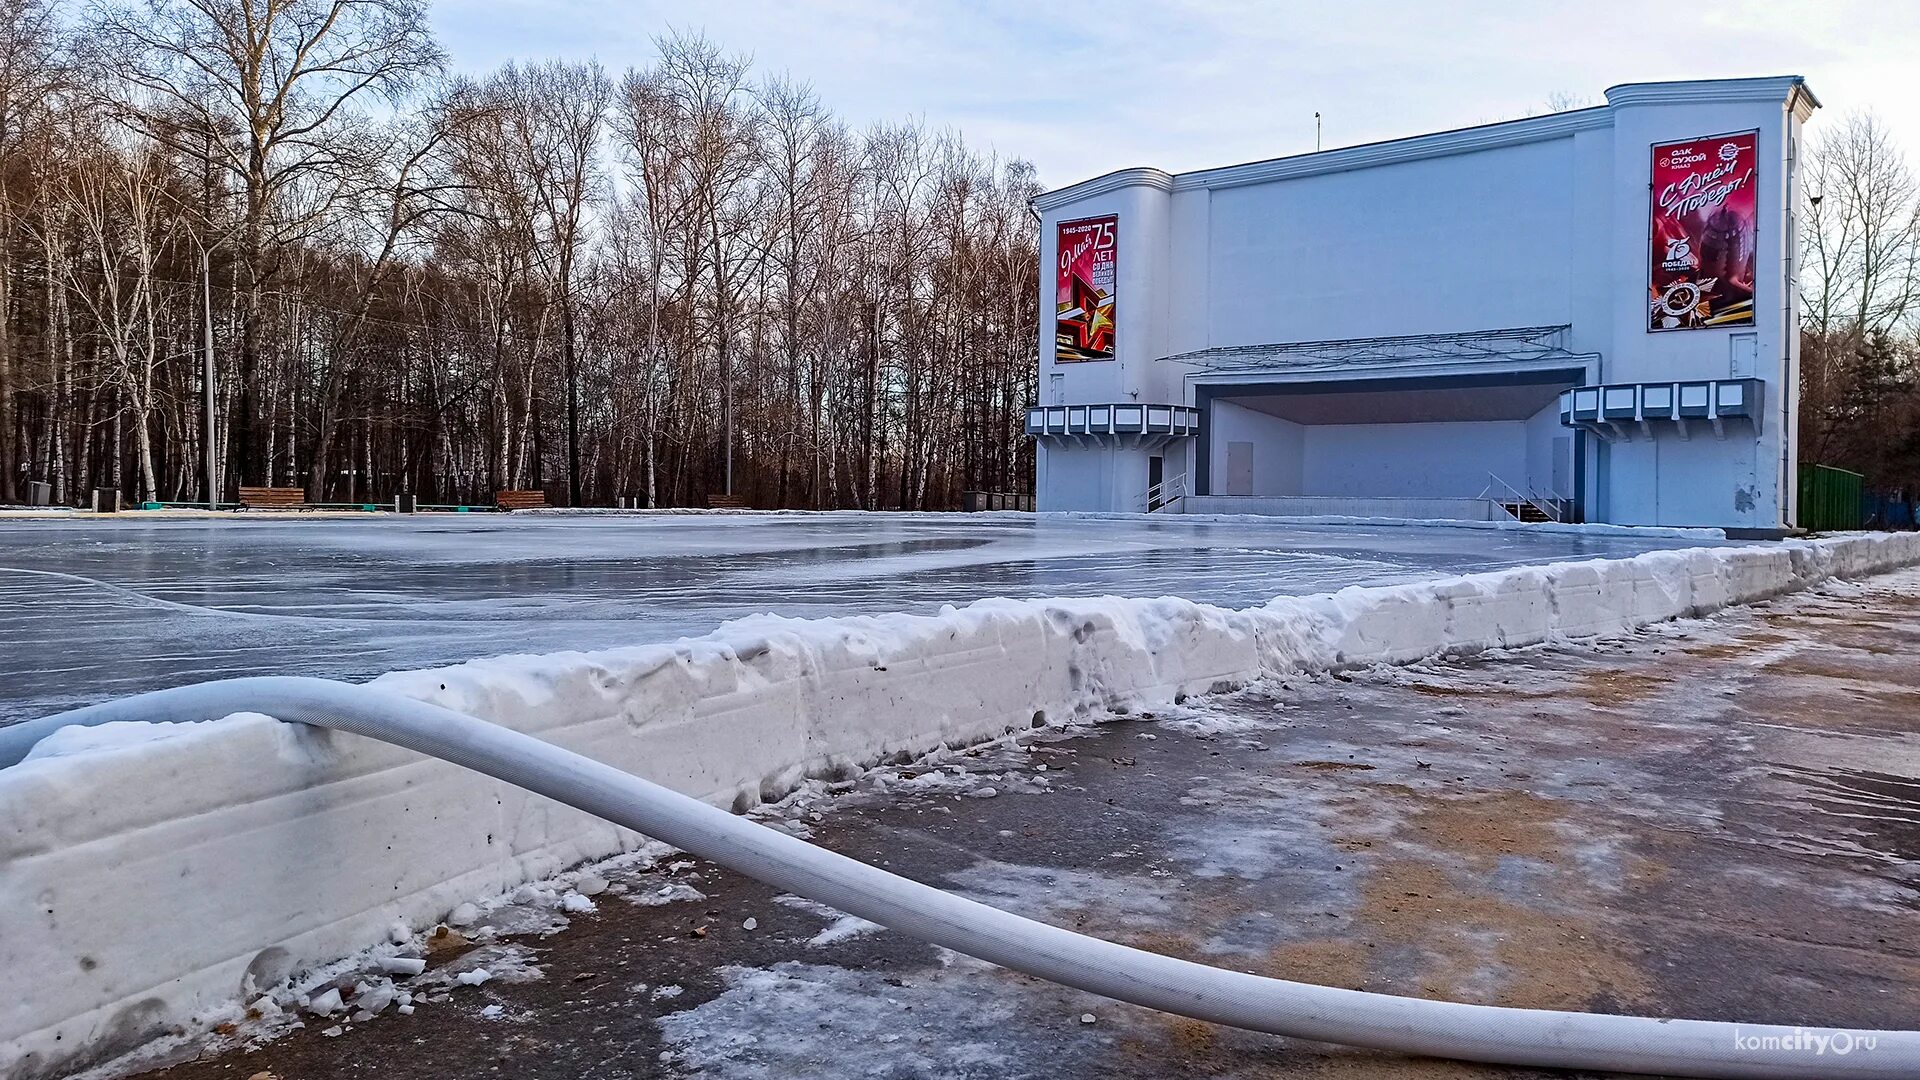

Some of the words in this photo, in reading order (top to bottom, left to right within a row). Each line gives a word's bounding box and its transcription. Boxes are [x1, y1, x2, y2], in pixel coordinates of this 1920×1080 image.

[1671, 153, 1707, 164] СУХОЙ
[1660, 182, 1678, 207] С
[1679, 160, 1737, 195] Днём
[1665, 168, 1752, 220] Победы!
[1063, 225, 1091, 234] 1945-2020
[1092, 222, 1114, 249] 75
[1093, 250, 1113, 262] ЛЕТ
[1667, 236, 1690, 260] 75
[1061, 250, 1071, 277] 9
[1093, 262, 1100, 271] СО
[1101, 261, 1113, 270] ДНЯ
